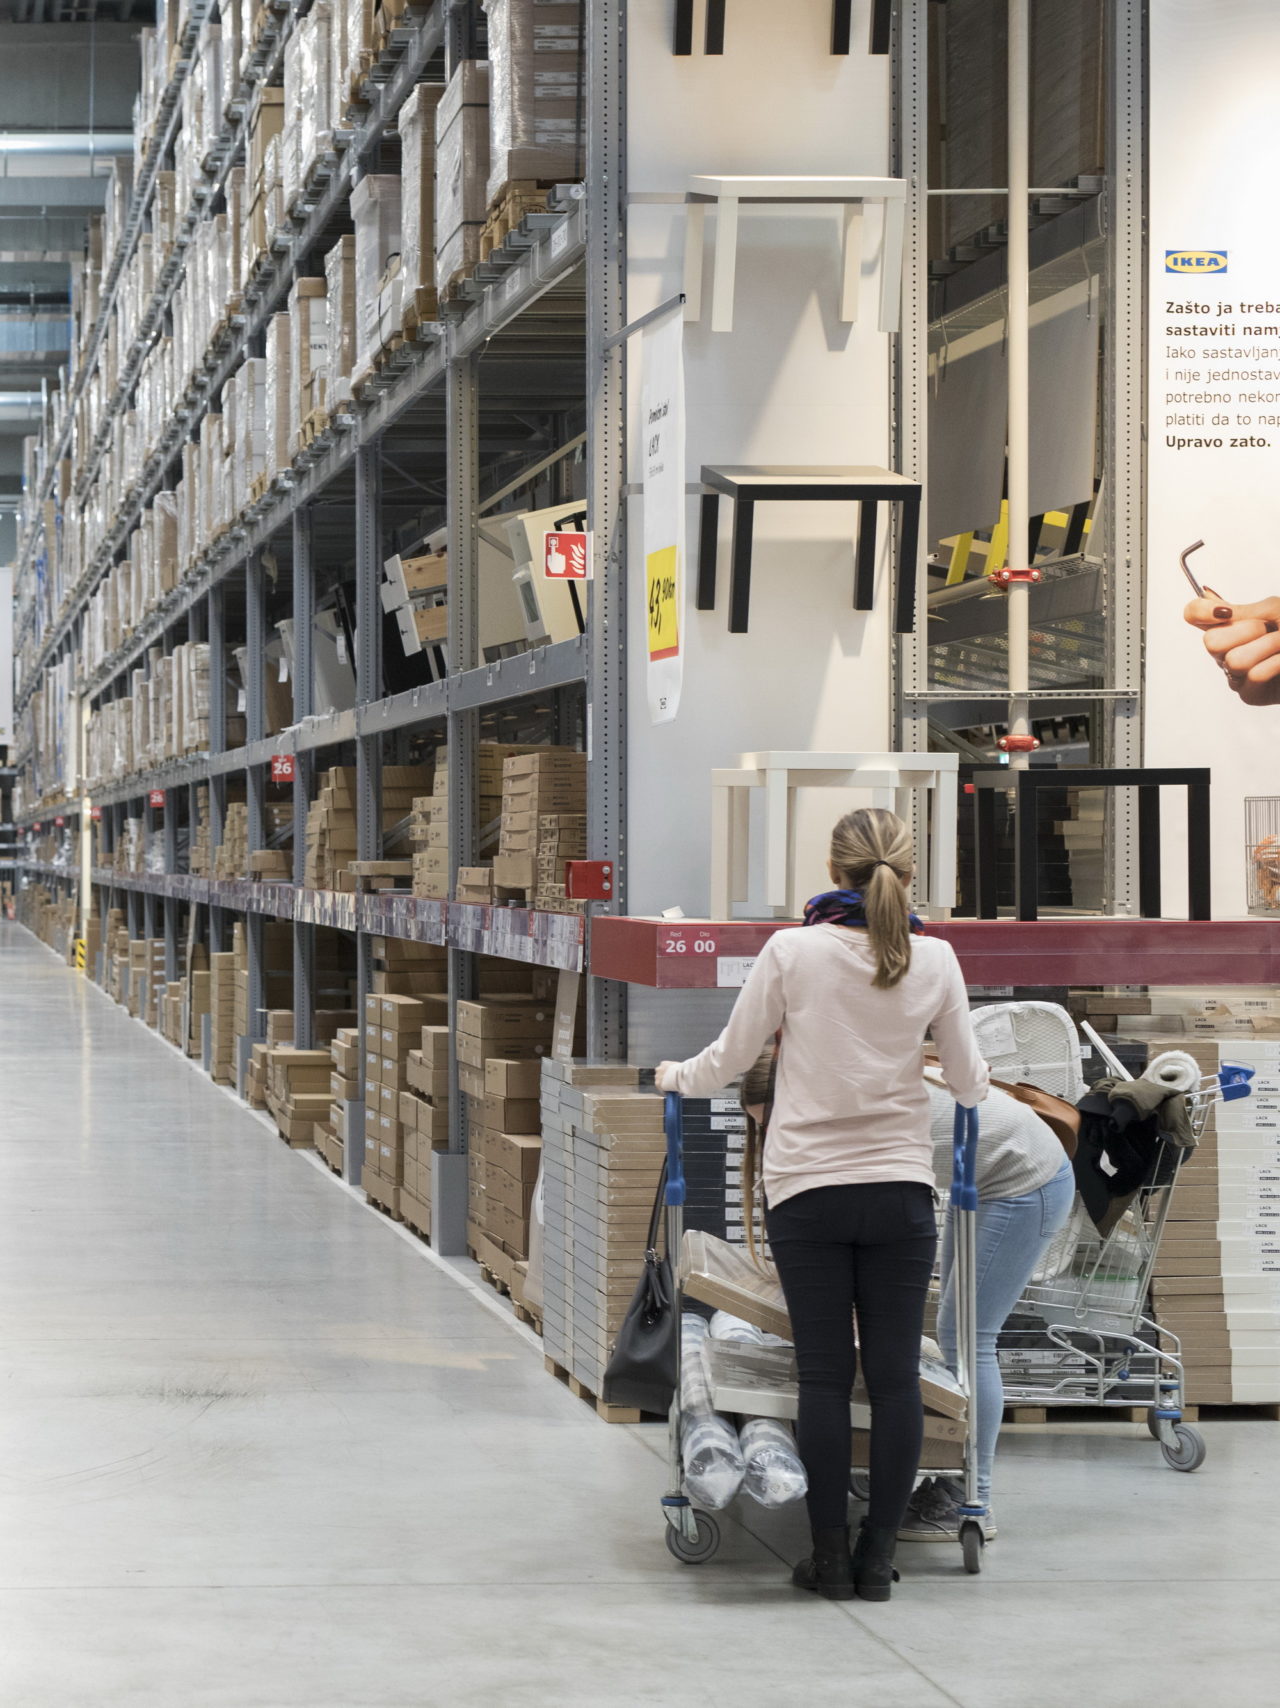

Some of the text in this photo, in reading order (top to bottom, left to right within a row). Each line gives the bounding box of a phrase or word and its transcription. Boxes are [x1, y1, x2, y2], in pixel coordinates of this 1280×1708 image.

[1172, 257, 1221, 266] IKEA
[1165, 301, 1211, 314] Zašto
[1215, 302, 1233, 316] ja
[1165, 324, 1236, 336] sastaviti
[1165, 346, 1197, 358] Iako
[1165, 369, 1169, 380] i
[1175, 369, 1201, 383] nije
[1165, 391, 1232, 405] potrebno
[1165, 413, 1205, 427] platiti
[1211, 413, 1230, 425] da
[1236, 414, 1252, 425] to
[1165, 436, 1271, 450] Upravo zato.
[273, 762, 292, 775] 26
[665, 940, 716, 953] 26 00
